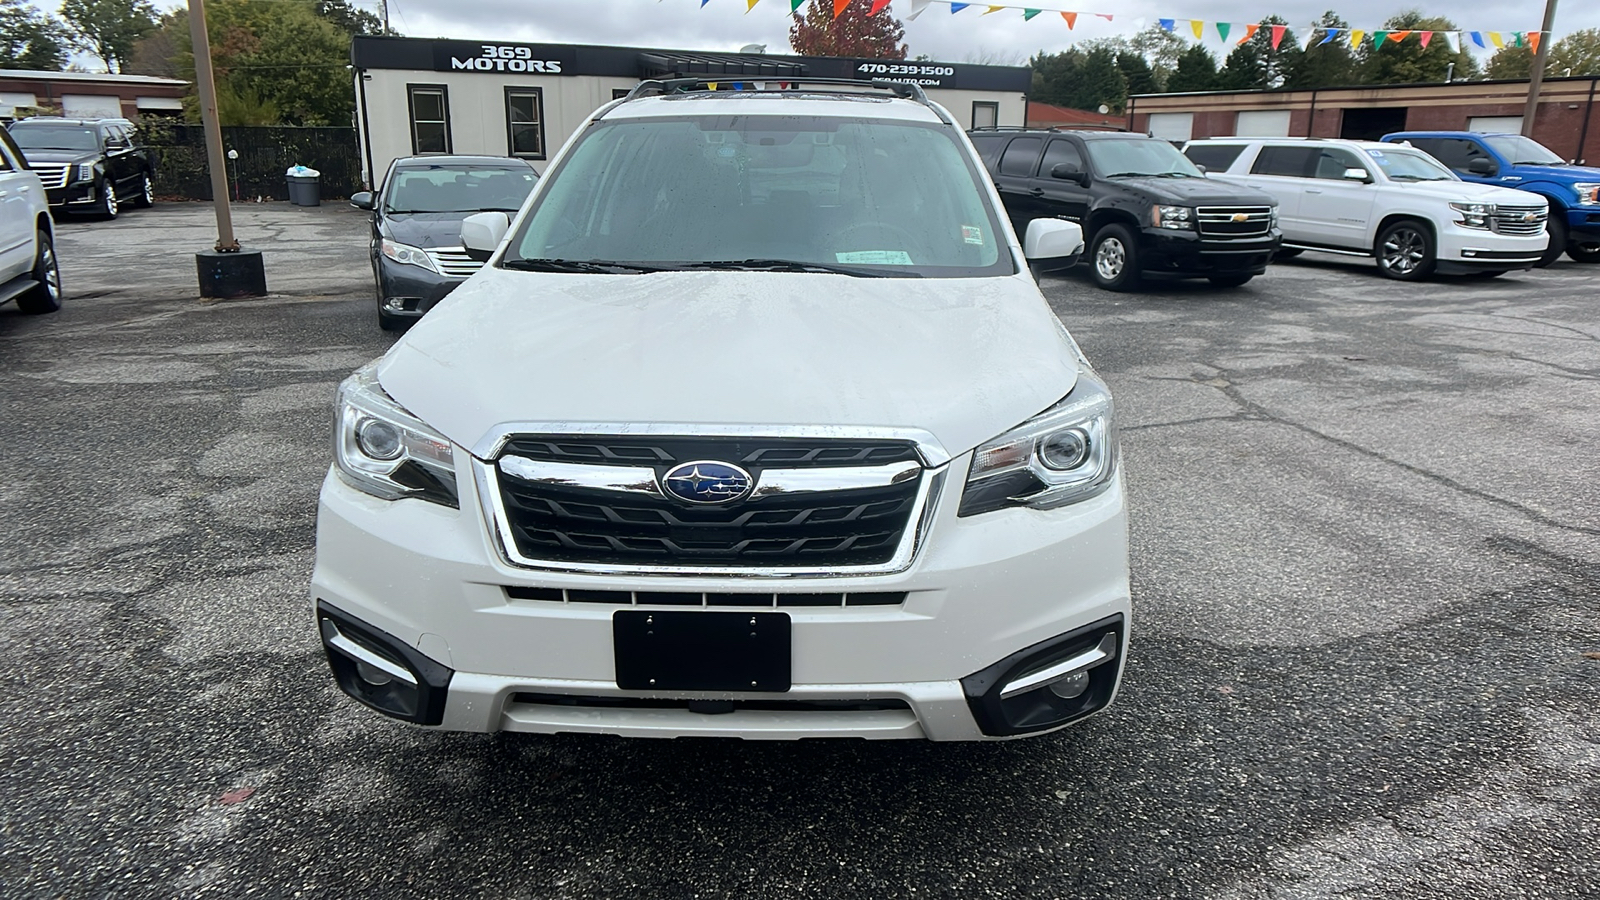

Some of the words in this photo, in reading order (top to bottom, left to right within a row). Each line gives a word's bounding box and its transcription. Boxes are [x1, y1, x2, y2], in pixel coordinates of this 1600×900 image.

[481, 45, 532, 59] 369
[451, 57, 562, 73] MOTORS
[857, 63, 954, 76] 470-239-1500
